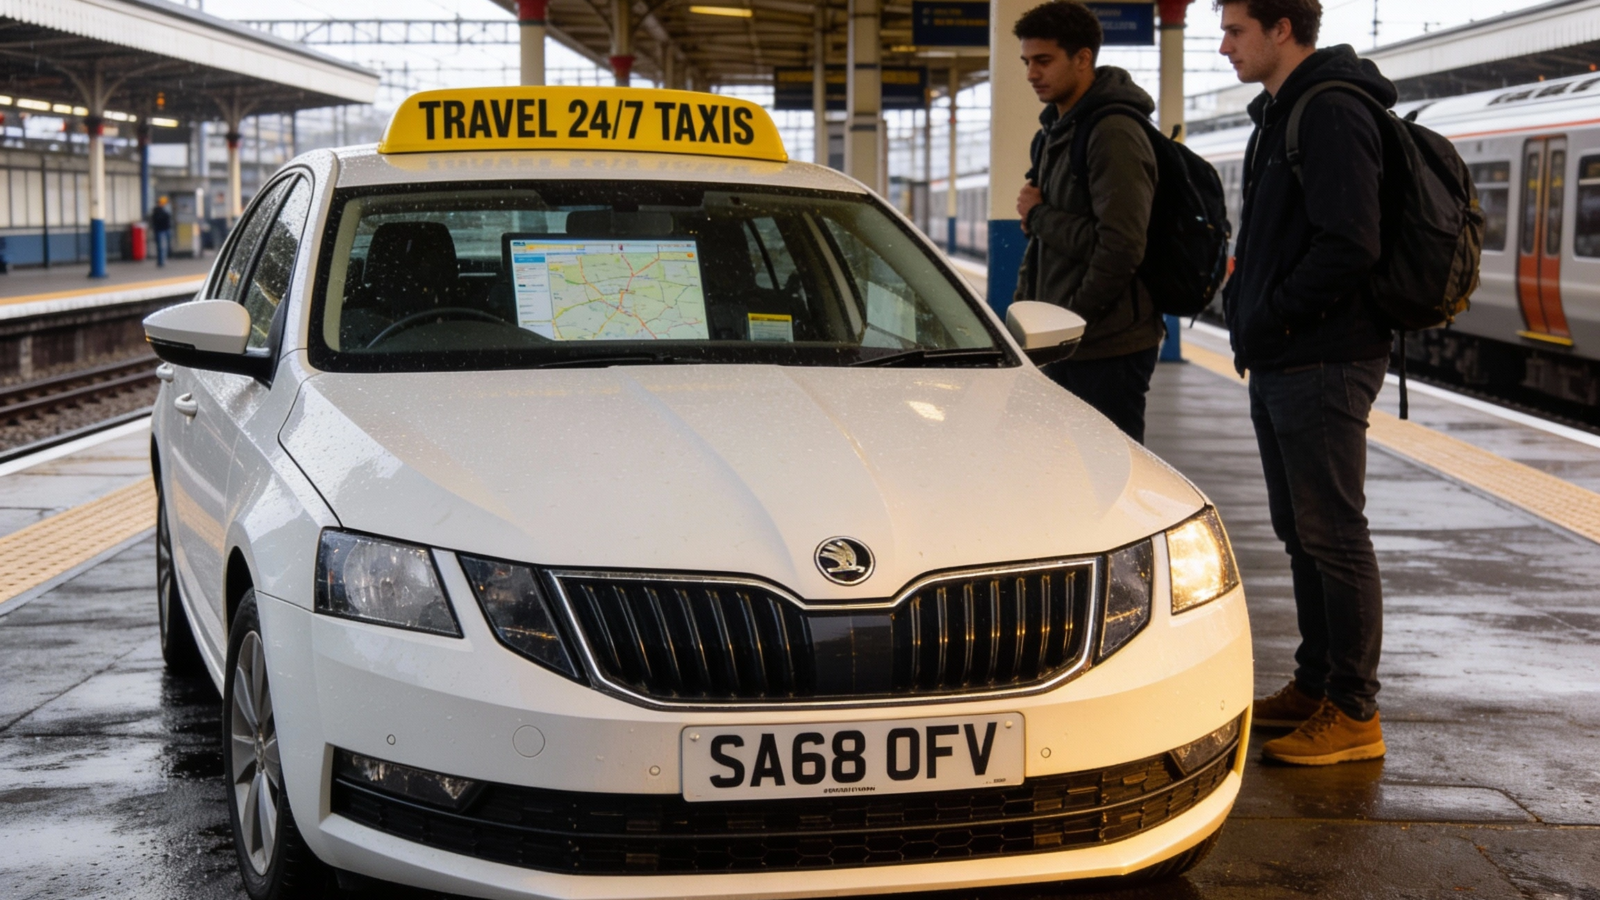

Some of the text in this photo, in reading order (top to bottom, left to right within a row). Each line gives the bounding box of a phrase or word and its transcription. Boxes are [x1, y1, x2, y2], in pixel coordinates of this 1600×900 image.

[419, 98, 755, 145] TRAVEL 24/7 TAXIS
[709, 721, 998, 789] SA68 OFV
